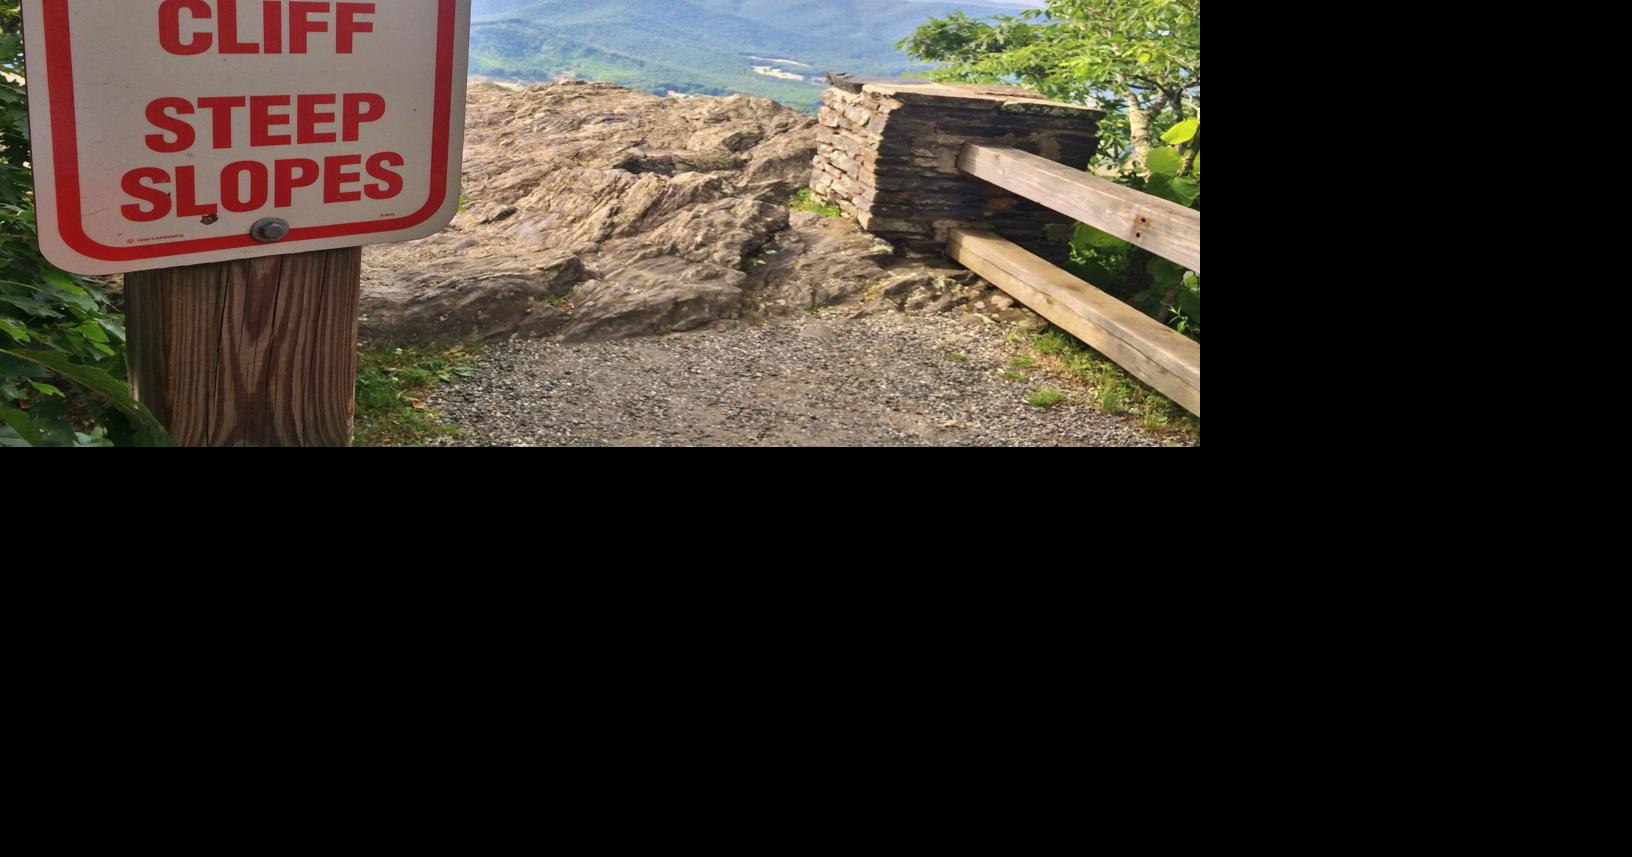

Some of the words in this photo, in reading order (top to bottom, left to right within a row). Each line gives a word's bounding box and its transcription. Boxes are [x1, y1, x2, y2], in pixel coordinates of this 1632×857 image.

[158, 0, 376, 56] CLIFF
[144, 92, 386, 153] STEEP
[119, 151, 405, 223] SLOPES
